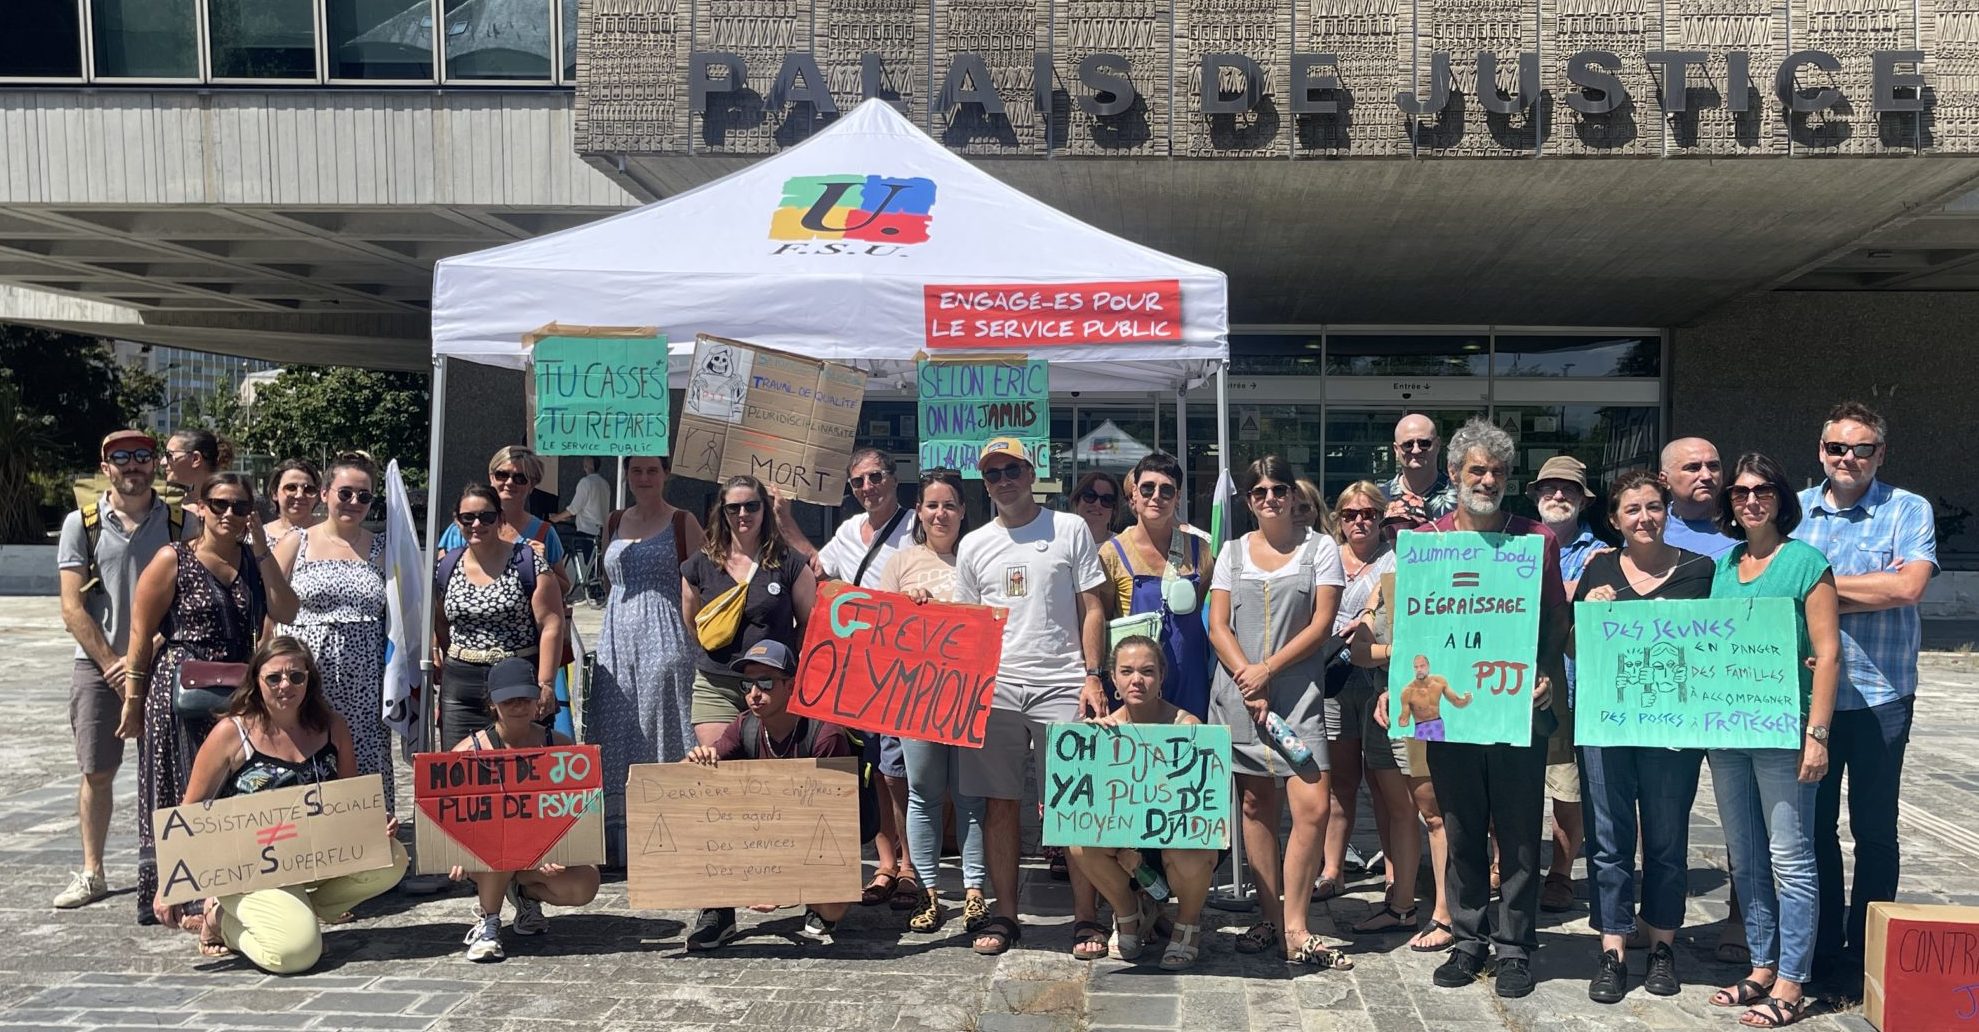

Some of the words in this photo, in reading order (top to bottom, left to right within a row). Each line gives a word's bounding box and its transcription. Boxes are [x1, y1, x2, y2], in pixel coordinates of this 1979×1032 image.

[689, 52, 1135, 116] PALAIS
[1199, 53, 1337, 114] DE
[1397, 50, 1925, 116] JUSTICE
[768, 243, 909, 258] F.S.U.
[939, 291, 1085, 312] ENGAGÉ-ES
[1092, 291, 1164, 312] POUR
[931, 319, 965, 337] LE
[974, 319, 1075, 339] SERVICE
[1083, 319, 1173, 338] PUBLIC
[537, 359, 577, 398] TU
[920, 364, 984, 399] SELON
[994, 364, 1043, 396] ERIC
[543, 407, 576, 435] TU
[586, 406, 667, 440] RÉPARES
[926, 404, 948, 436] ON
[977, 401, 1037, 431] JAMAIS
[542, 442, 555, 450] LE
[561, 441, 600, 450] SERVICE
[610, 442, 653, 453] PUBLIC
[751, 454, 831, 492] MORT
[1401, 546, 1485, 564] summer
[1493, 543, 1537, 579] body
[1407, 591, 1526, 616] DÉGRAISSAGE
[1465, 631, 1482, 649] LA
[1603, 620, 1644, 641] DES
[1652, 618, 1738, 642] JEUNES
[1694, 641, 1718, 652] EN
[1731, 642, 1782, 656] DANGER
[1472, 660, 1529, 696] PJJ
[1691, 665, 1716, 679] DES
[1725, 663, 1784, 684] FAMILLES
[799, 639, 996, 744] OLYMPIQUE
[1702, 691, 1793, 706] ACCOMPAGNER
[1600, 711, 1628, 727] DES
[1639, 711, 1685, 728] POSTES
[1704, 709, 1799, 736] PROTÉGER
[1055, 729, 1097, 762] OH
[515, 754, 541, 785] DE
[549, 751, 591, 784] JO
[438, 795, 492, 823] PLUS
[502, 794, 533, 820] DE
[1105, 778, 1173, 815] PLUS
[1168, 786, 1218, 816] DE
[742, 805, 783, 831] agents
[1056, 811, 1134, 843] MOYEN
[260, 845, 364, 875] SUPERFLU
[743, 864, 783, 881] jeunes
[1899, 928, 1979, 976] CONTR
